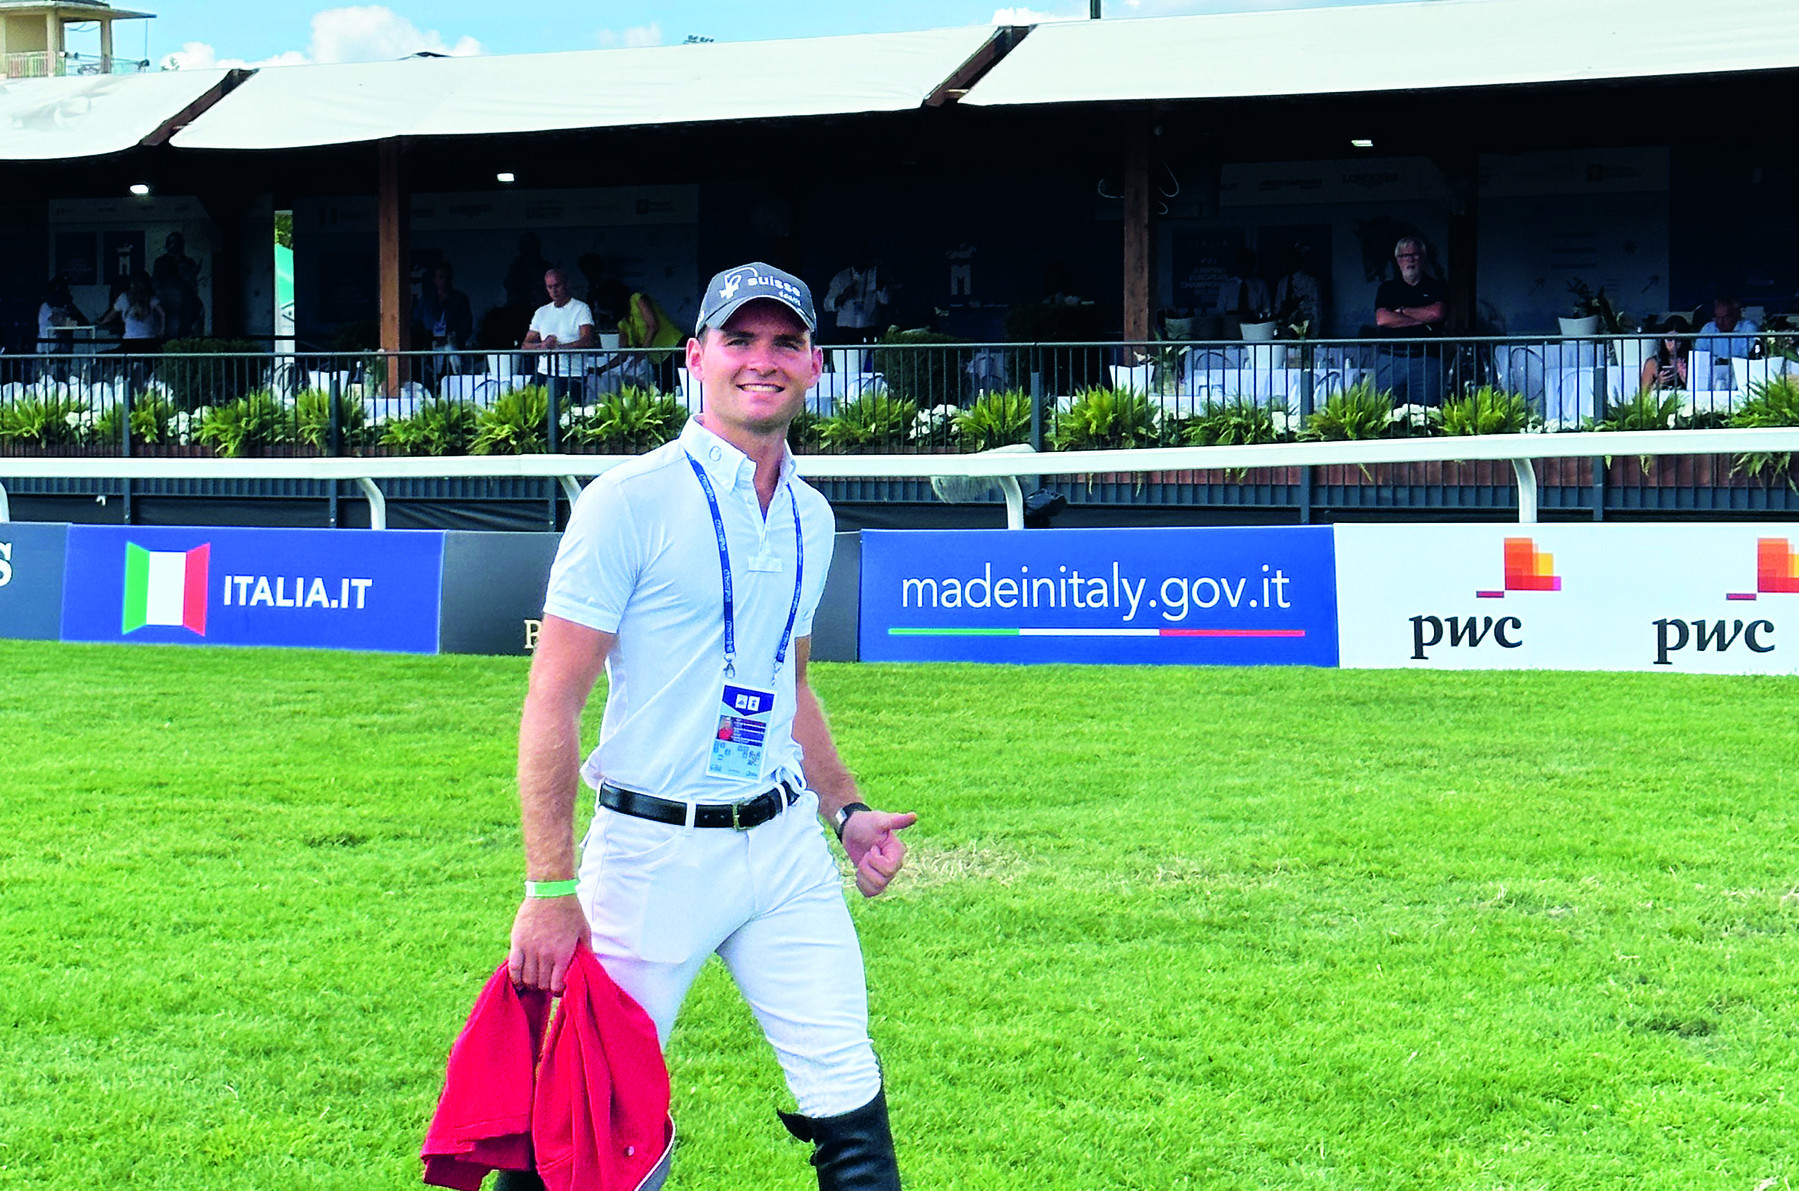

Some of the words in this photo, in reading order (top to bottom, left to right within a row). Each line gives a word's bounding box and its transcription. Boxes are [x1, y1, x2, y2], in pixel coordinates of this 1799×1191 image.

[747, 275, 801, 298] suisse
[223, 574, 373, 610] ITALIA.IT
[901, 561, 1292, 622] madeinitaly.gov.it
[1408, 614, 1523, 661] pwc
[1651, 617, 1776, 666] pwc
